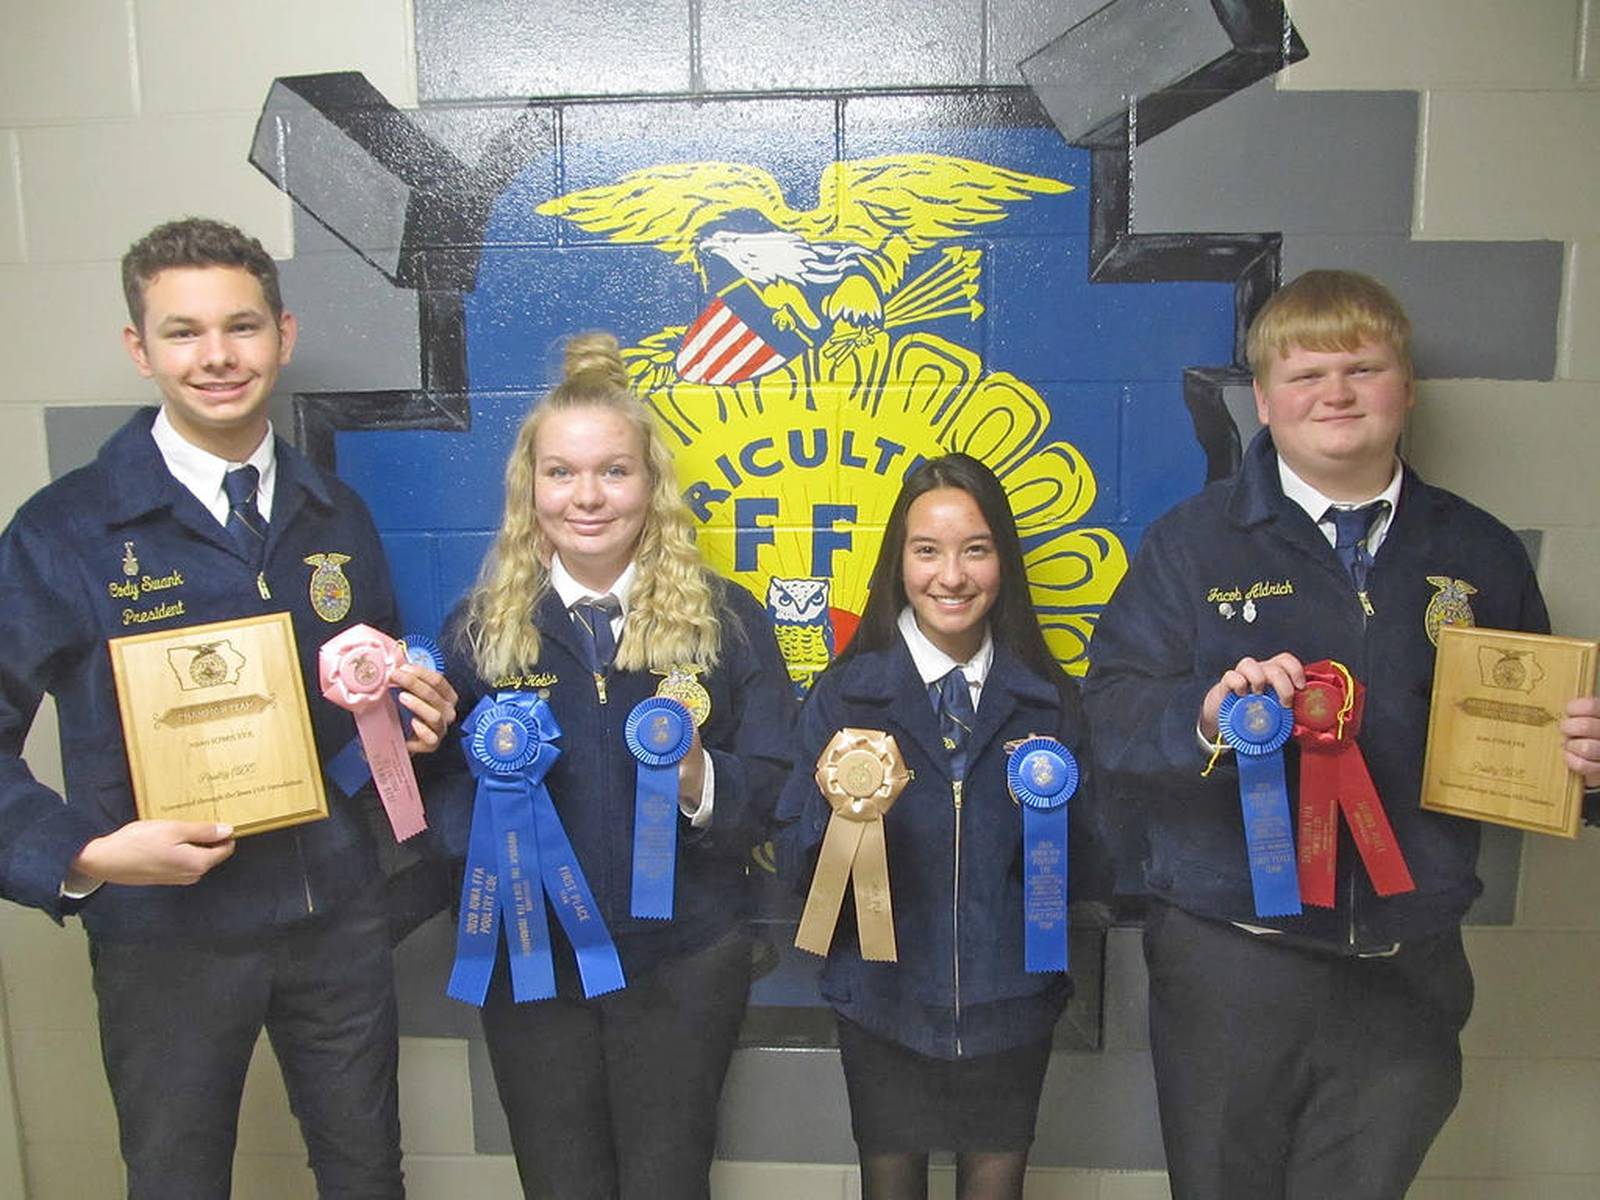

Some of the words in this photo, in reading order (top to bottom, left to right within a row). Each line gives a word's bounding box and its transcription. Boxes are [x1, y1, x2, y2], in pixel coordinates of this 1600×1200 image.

[108, 580, 139, 600] Cody
[141, 569, 184, 592] Swank
[1207, 586, 1242, 602] Jacob
[1245, 580, 1293, 599] Aldrich
[122, 600, 186, 625] President
